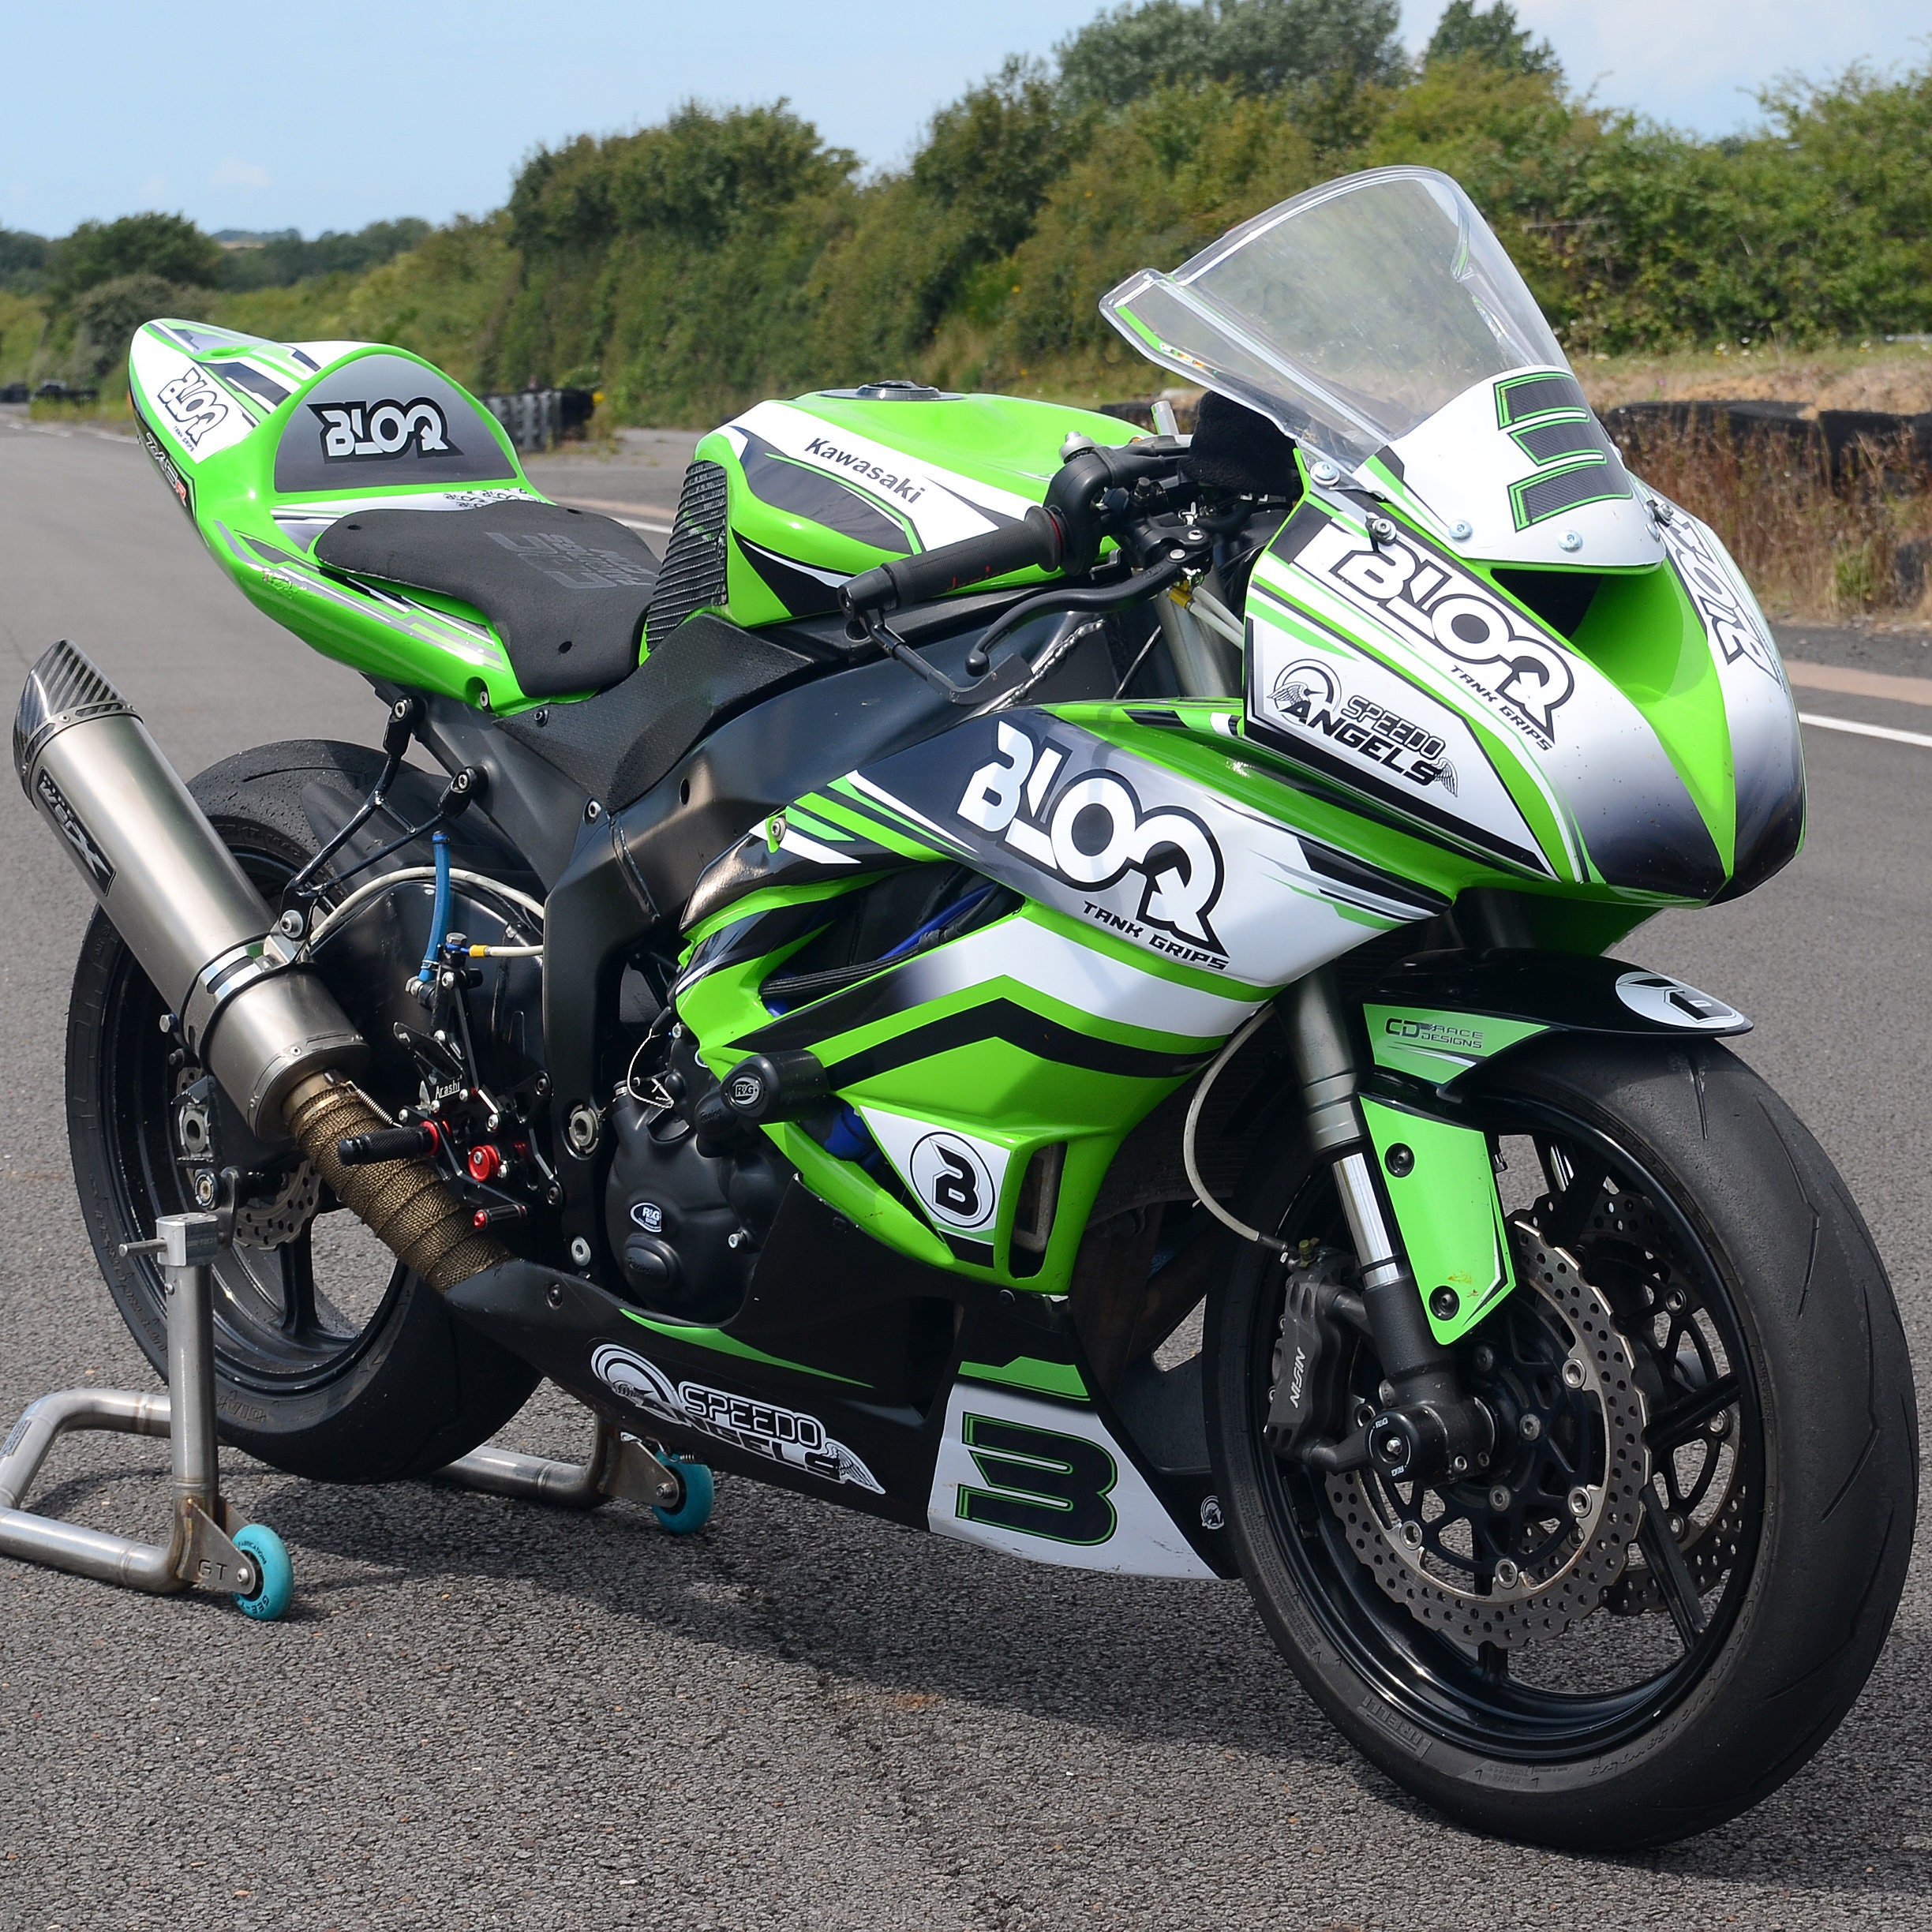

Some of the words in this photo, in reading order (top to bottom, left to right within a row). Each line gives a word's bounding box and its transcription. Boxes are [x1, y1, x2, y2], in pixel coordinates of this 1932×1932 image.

[157, 367, 229, 447] BLOQ
[319, 401, 455, 459] BLOQ
[804, 436, 926, 506] Kawasaki
[1328, 549, 1575, 744] BLOQ
[1342, 695, 1447, 759] SPEEDO
[1451, 665, 1499, 708] TANK
[1499, 705, 1553, 751] GRIPS
[1278, 699, 1439, 786] ANGELS
[956, 719, 1225, 949] BLOQ
[1083, 900, 1144, 938] TANK
[1148, 934, 1230, 971] GRIPS
[1385, 1018, 1421, 1038] CD
[1421, 1032, 1482, 1049] DESIGNS
[435, 1074, 463, 1100] Arashi
[735, 1084, 754, 1095] R&G
[642, 1207, 661, 1222] R&G
[1290, 1346, 1306, 1409] NISSIN
[682, 1384, 824, 1447] SPEEDO
[955, 1410, 1118, 1547] 3
